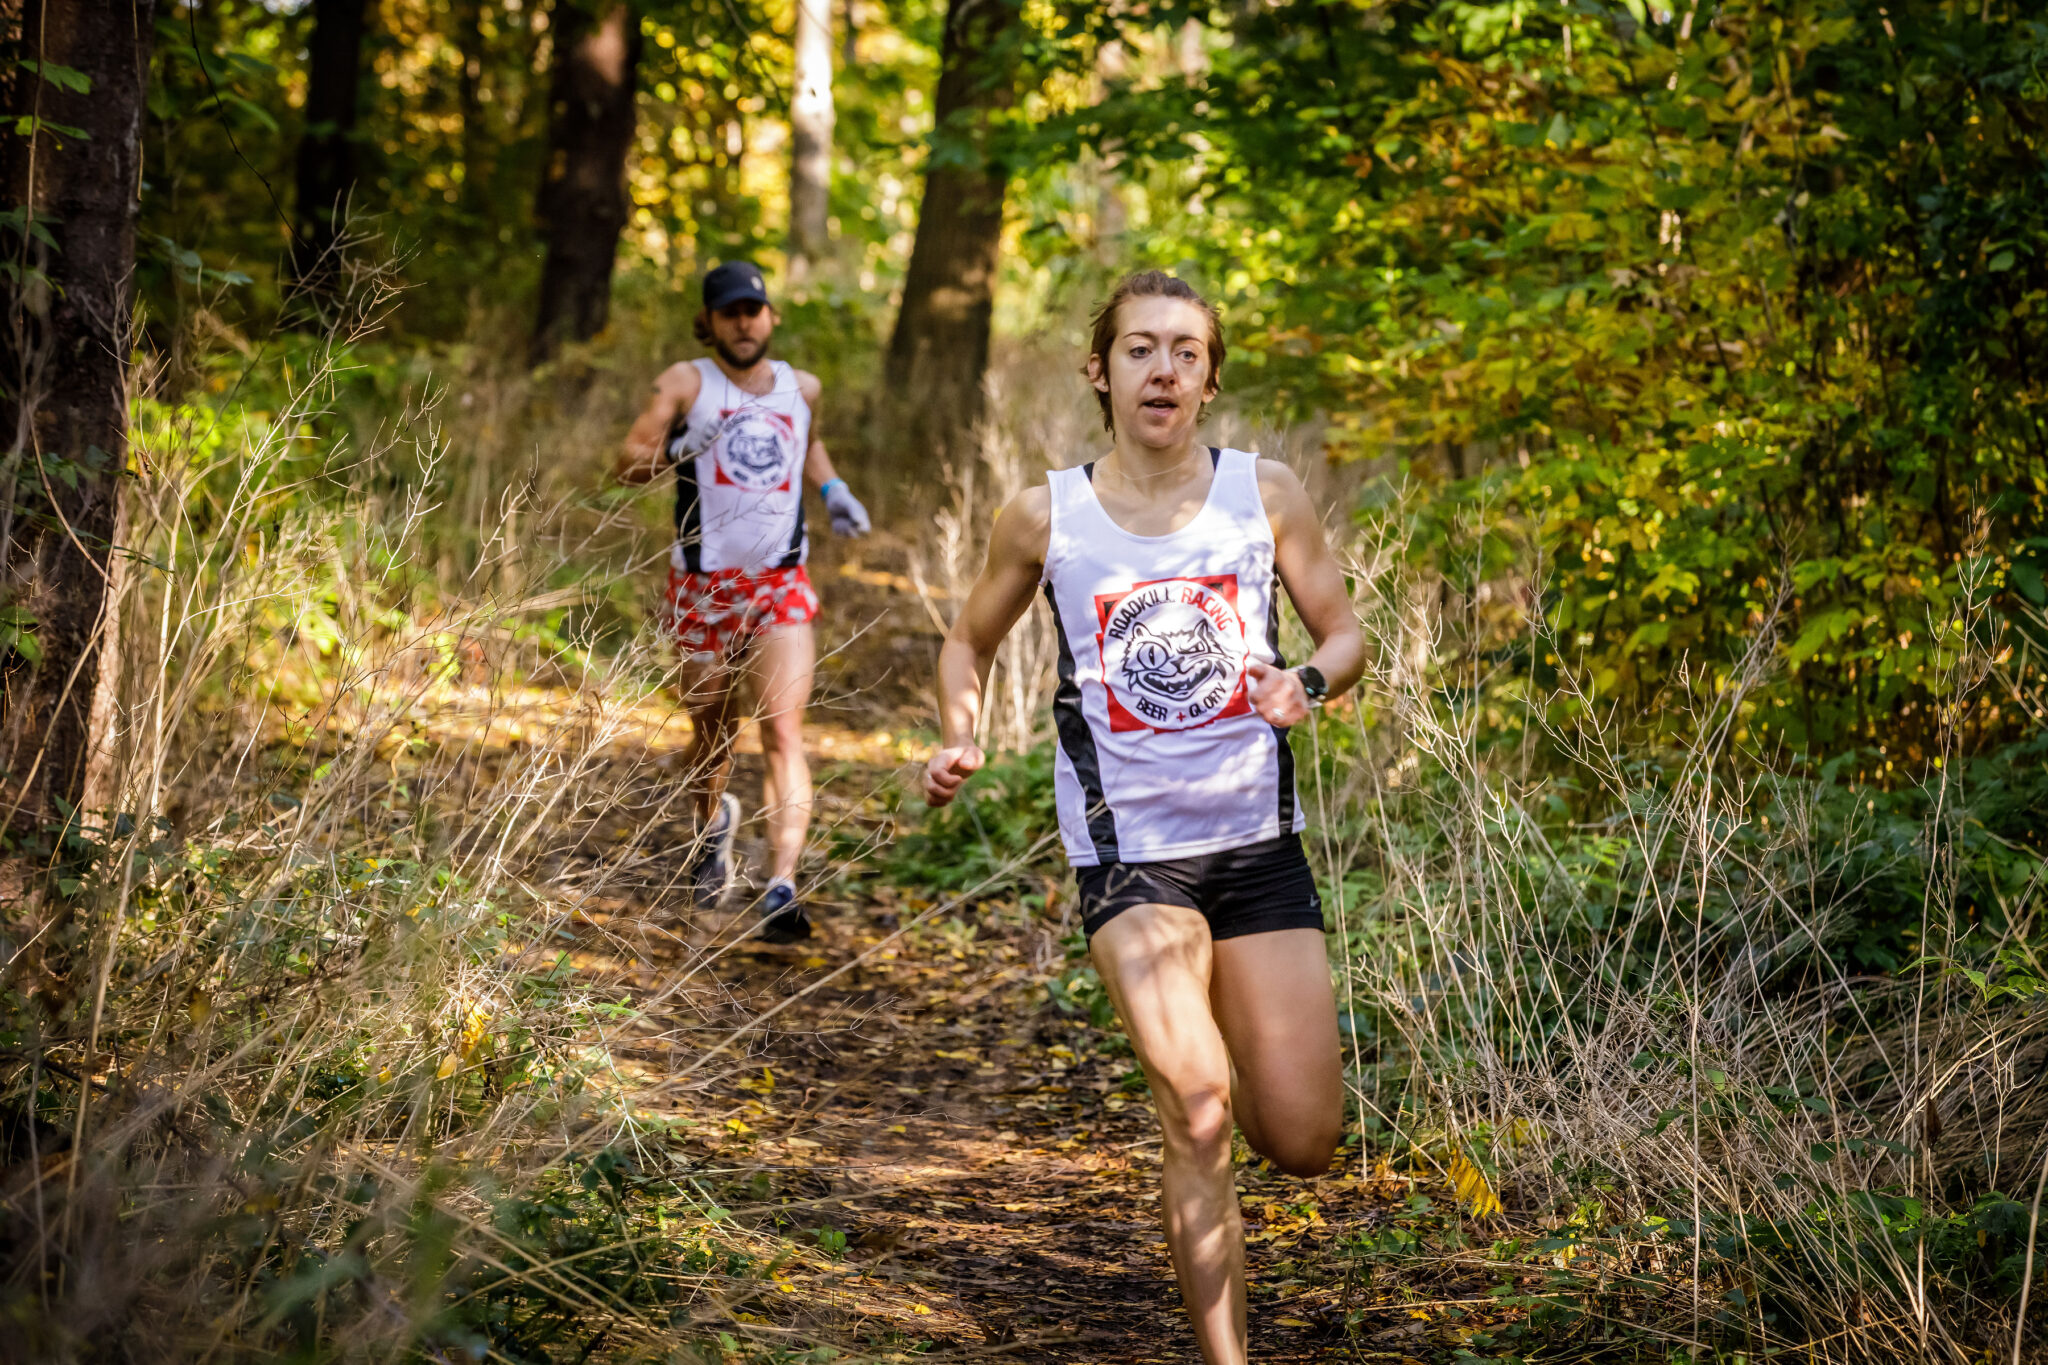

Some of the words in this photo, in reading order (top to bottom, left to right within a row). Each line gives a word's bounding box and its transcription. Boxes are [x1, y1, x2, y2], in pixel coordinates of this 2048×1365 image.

[1108, 586, 1175, 640] ROADKILL
[1181, 586, 1233, 631] RACING
[1136, 696, 1168, 721] BEER
[1189, 682, 1227, 718] GLORY
